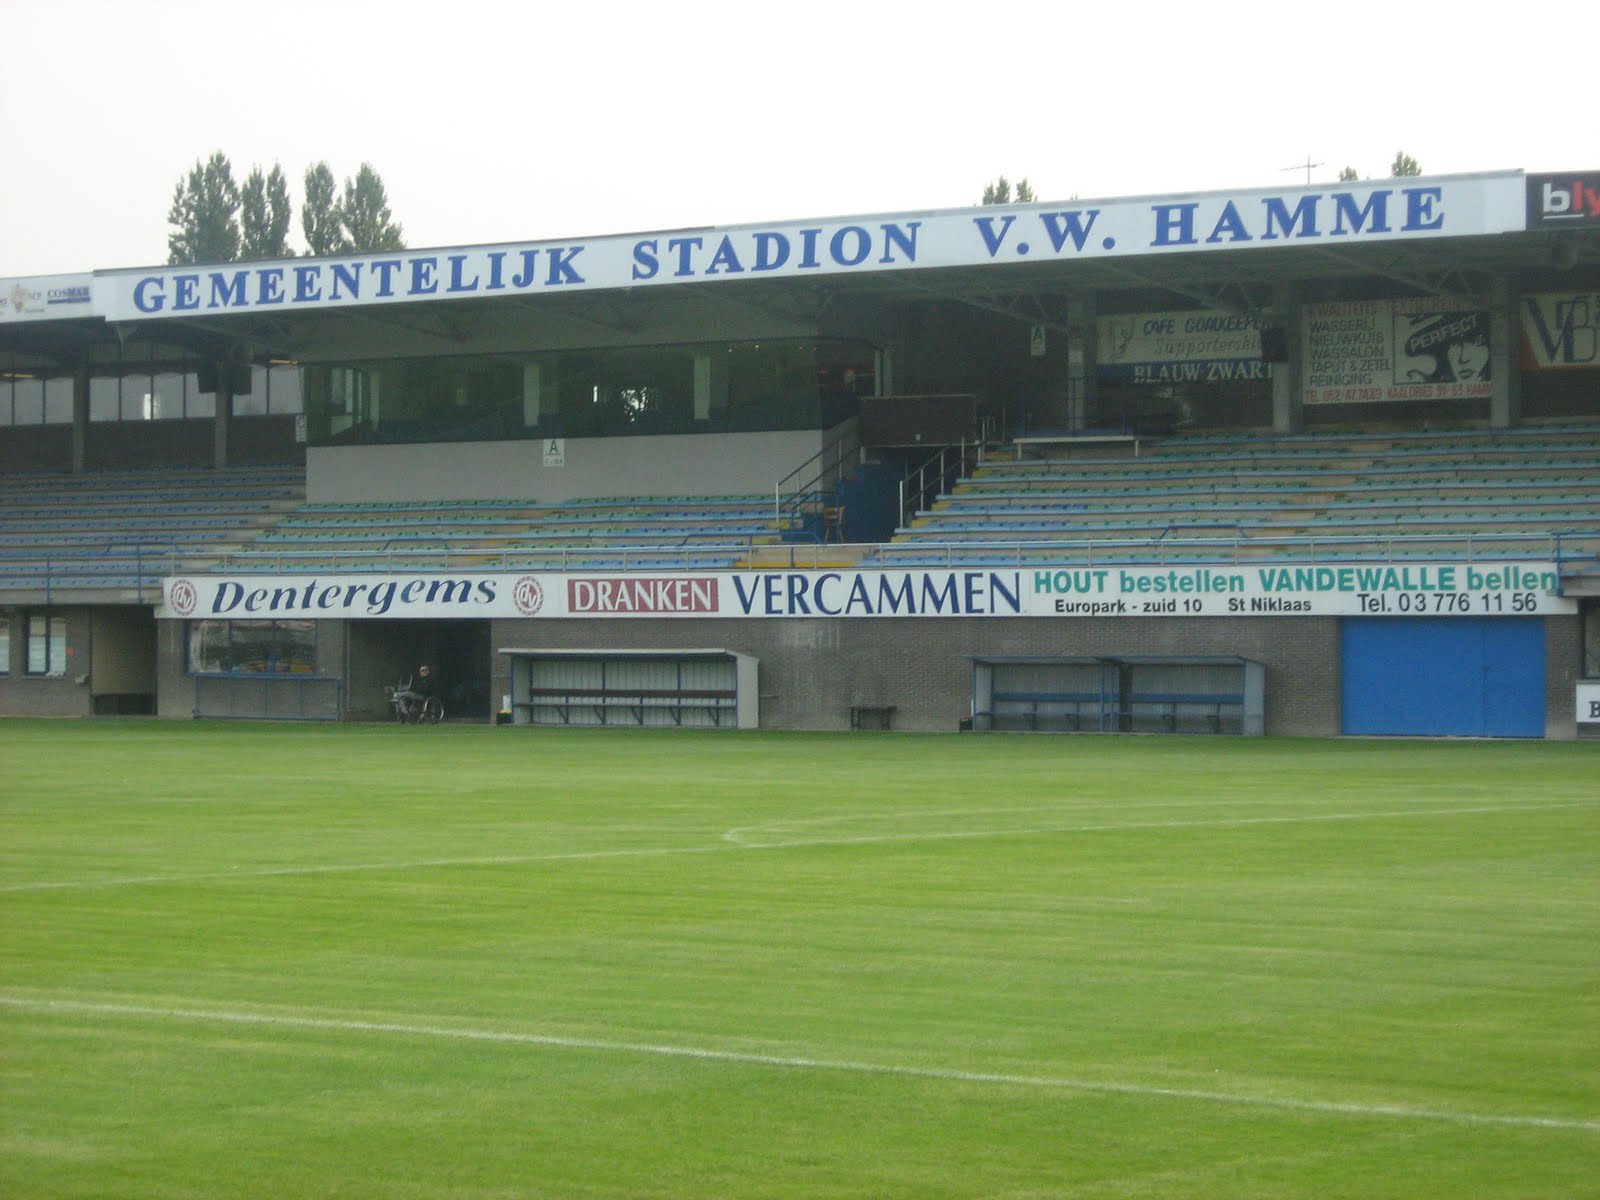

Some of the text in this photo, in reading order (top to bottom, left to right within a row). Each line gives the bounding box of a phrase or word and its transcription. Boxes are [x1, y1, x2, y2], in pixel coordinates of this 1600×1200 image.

[133, 246, 585, 313] GEMEENTELIJK
[632, 222, 922, 281] STADION
[1150, 187, 1445, 247] HAMME
[1409, 315, 1478, 352] PERFECT
[549, 439, 559, 454] A
[574, 579, 712, 612] DRANKEN
[732, 572, 1021, 616] VERCAMMEN
[1034, 566, 1558, 593] HOUT bestellen VANDEWALLE bellen
[212, 578, 497, 616] Dentergems
[1055, 599, 1126, 616] Europark
[1143, 598, 1176, 613] zuid
[1184, 598, 1203, 612] 10
[1228, 597, 1246, 612] St
[1251, 597, 1312, 612] Niklaas
[1357, 593, 1392, 613] Tel.
[1433, 593, 1470, 612] 776
[1481, 593, 1502, 612] 11
[1512, 593, 1537, 612] 56
